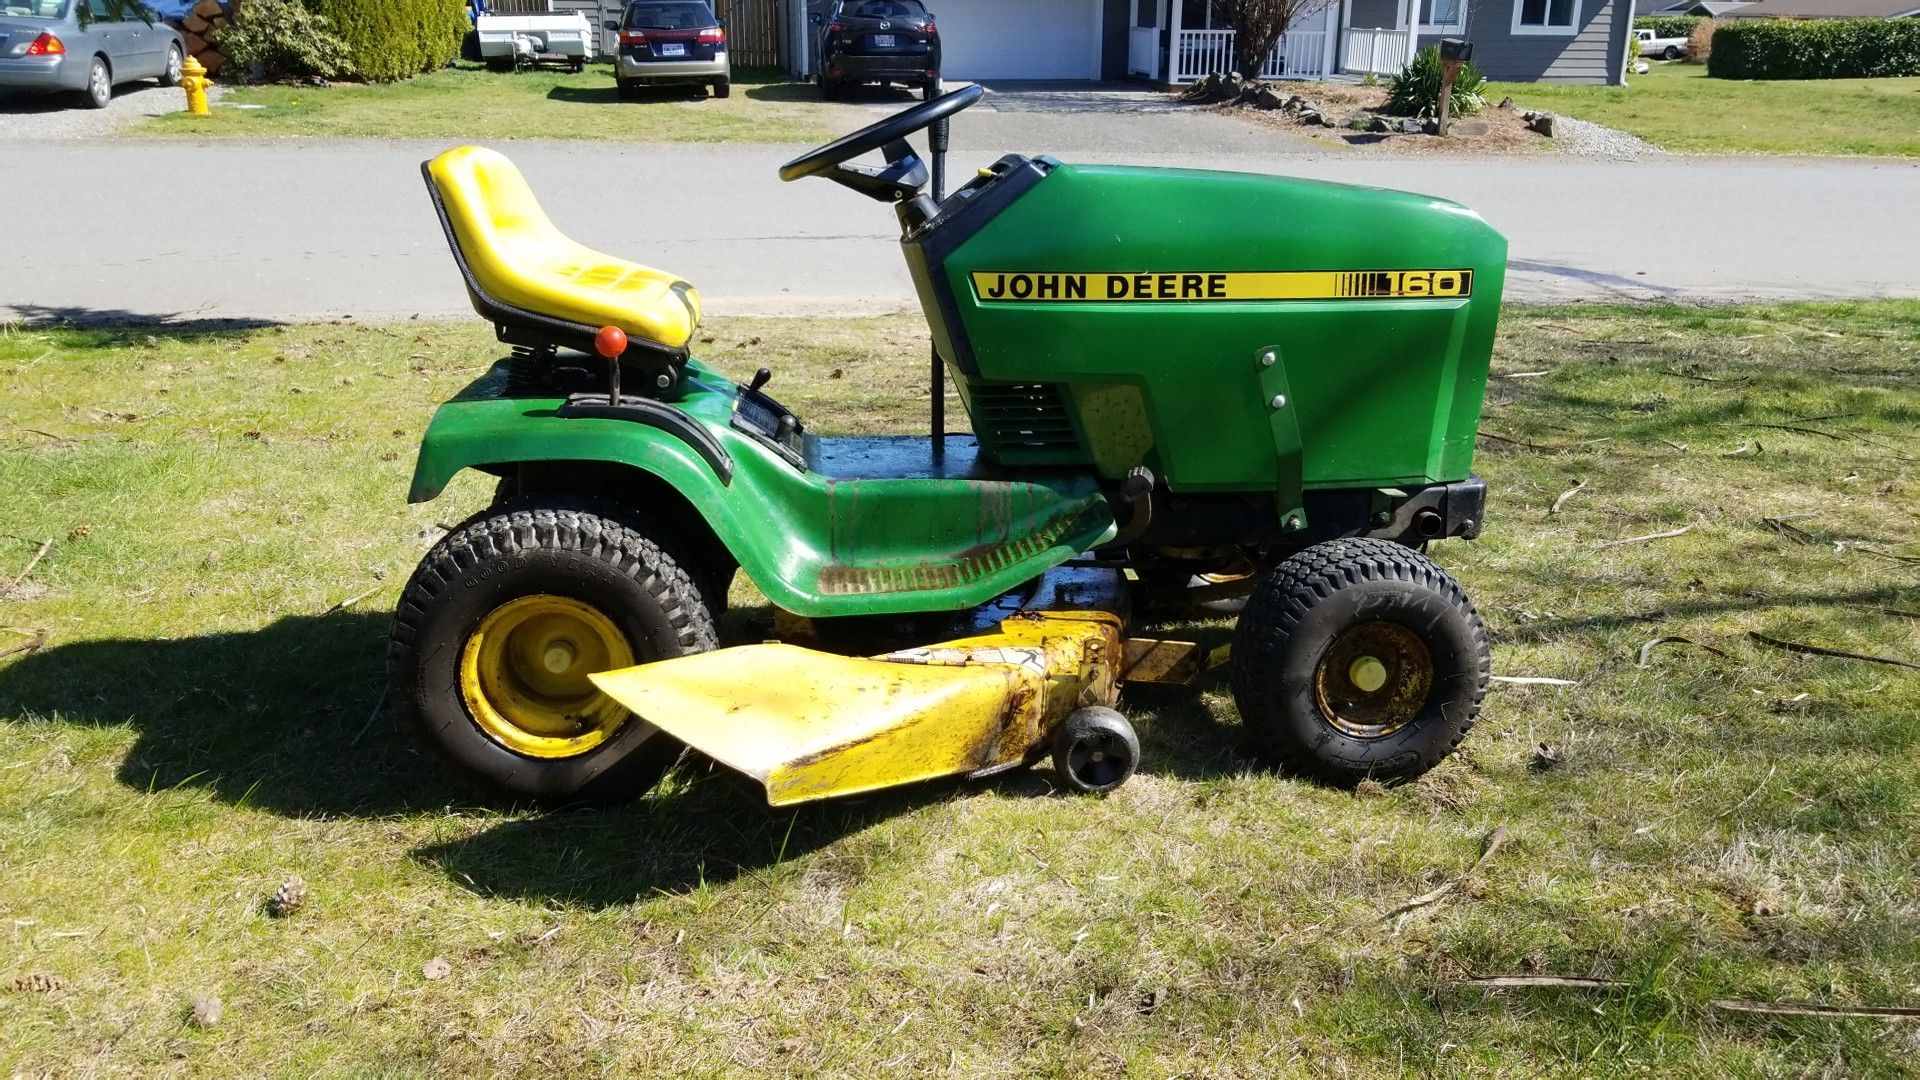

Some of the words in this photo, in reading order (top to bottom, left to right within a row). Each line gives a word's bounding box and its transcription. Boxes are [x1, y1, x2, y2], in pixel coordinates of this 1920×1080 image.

[988, 274, 1087, 299] JOHN
[1107, 274, 1227, 298] DEERE
[1386, 271, 1462, 297] 160
